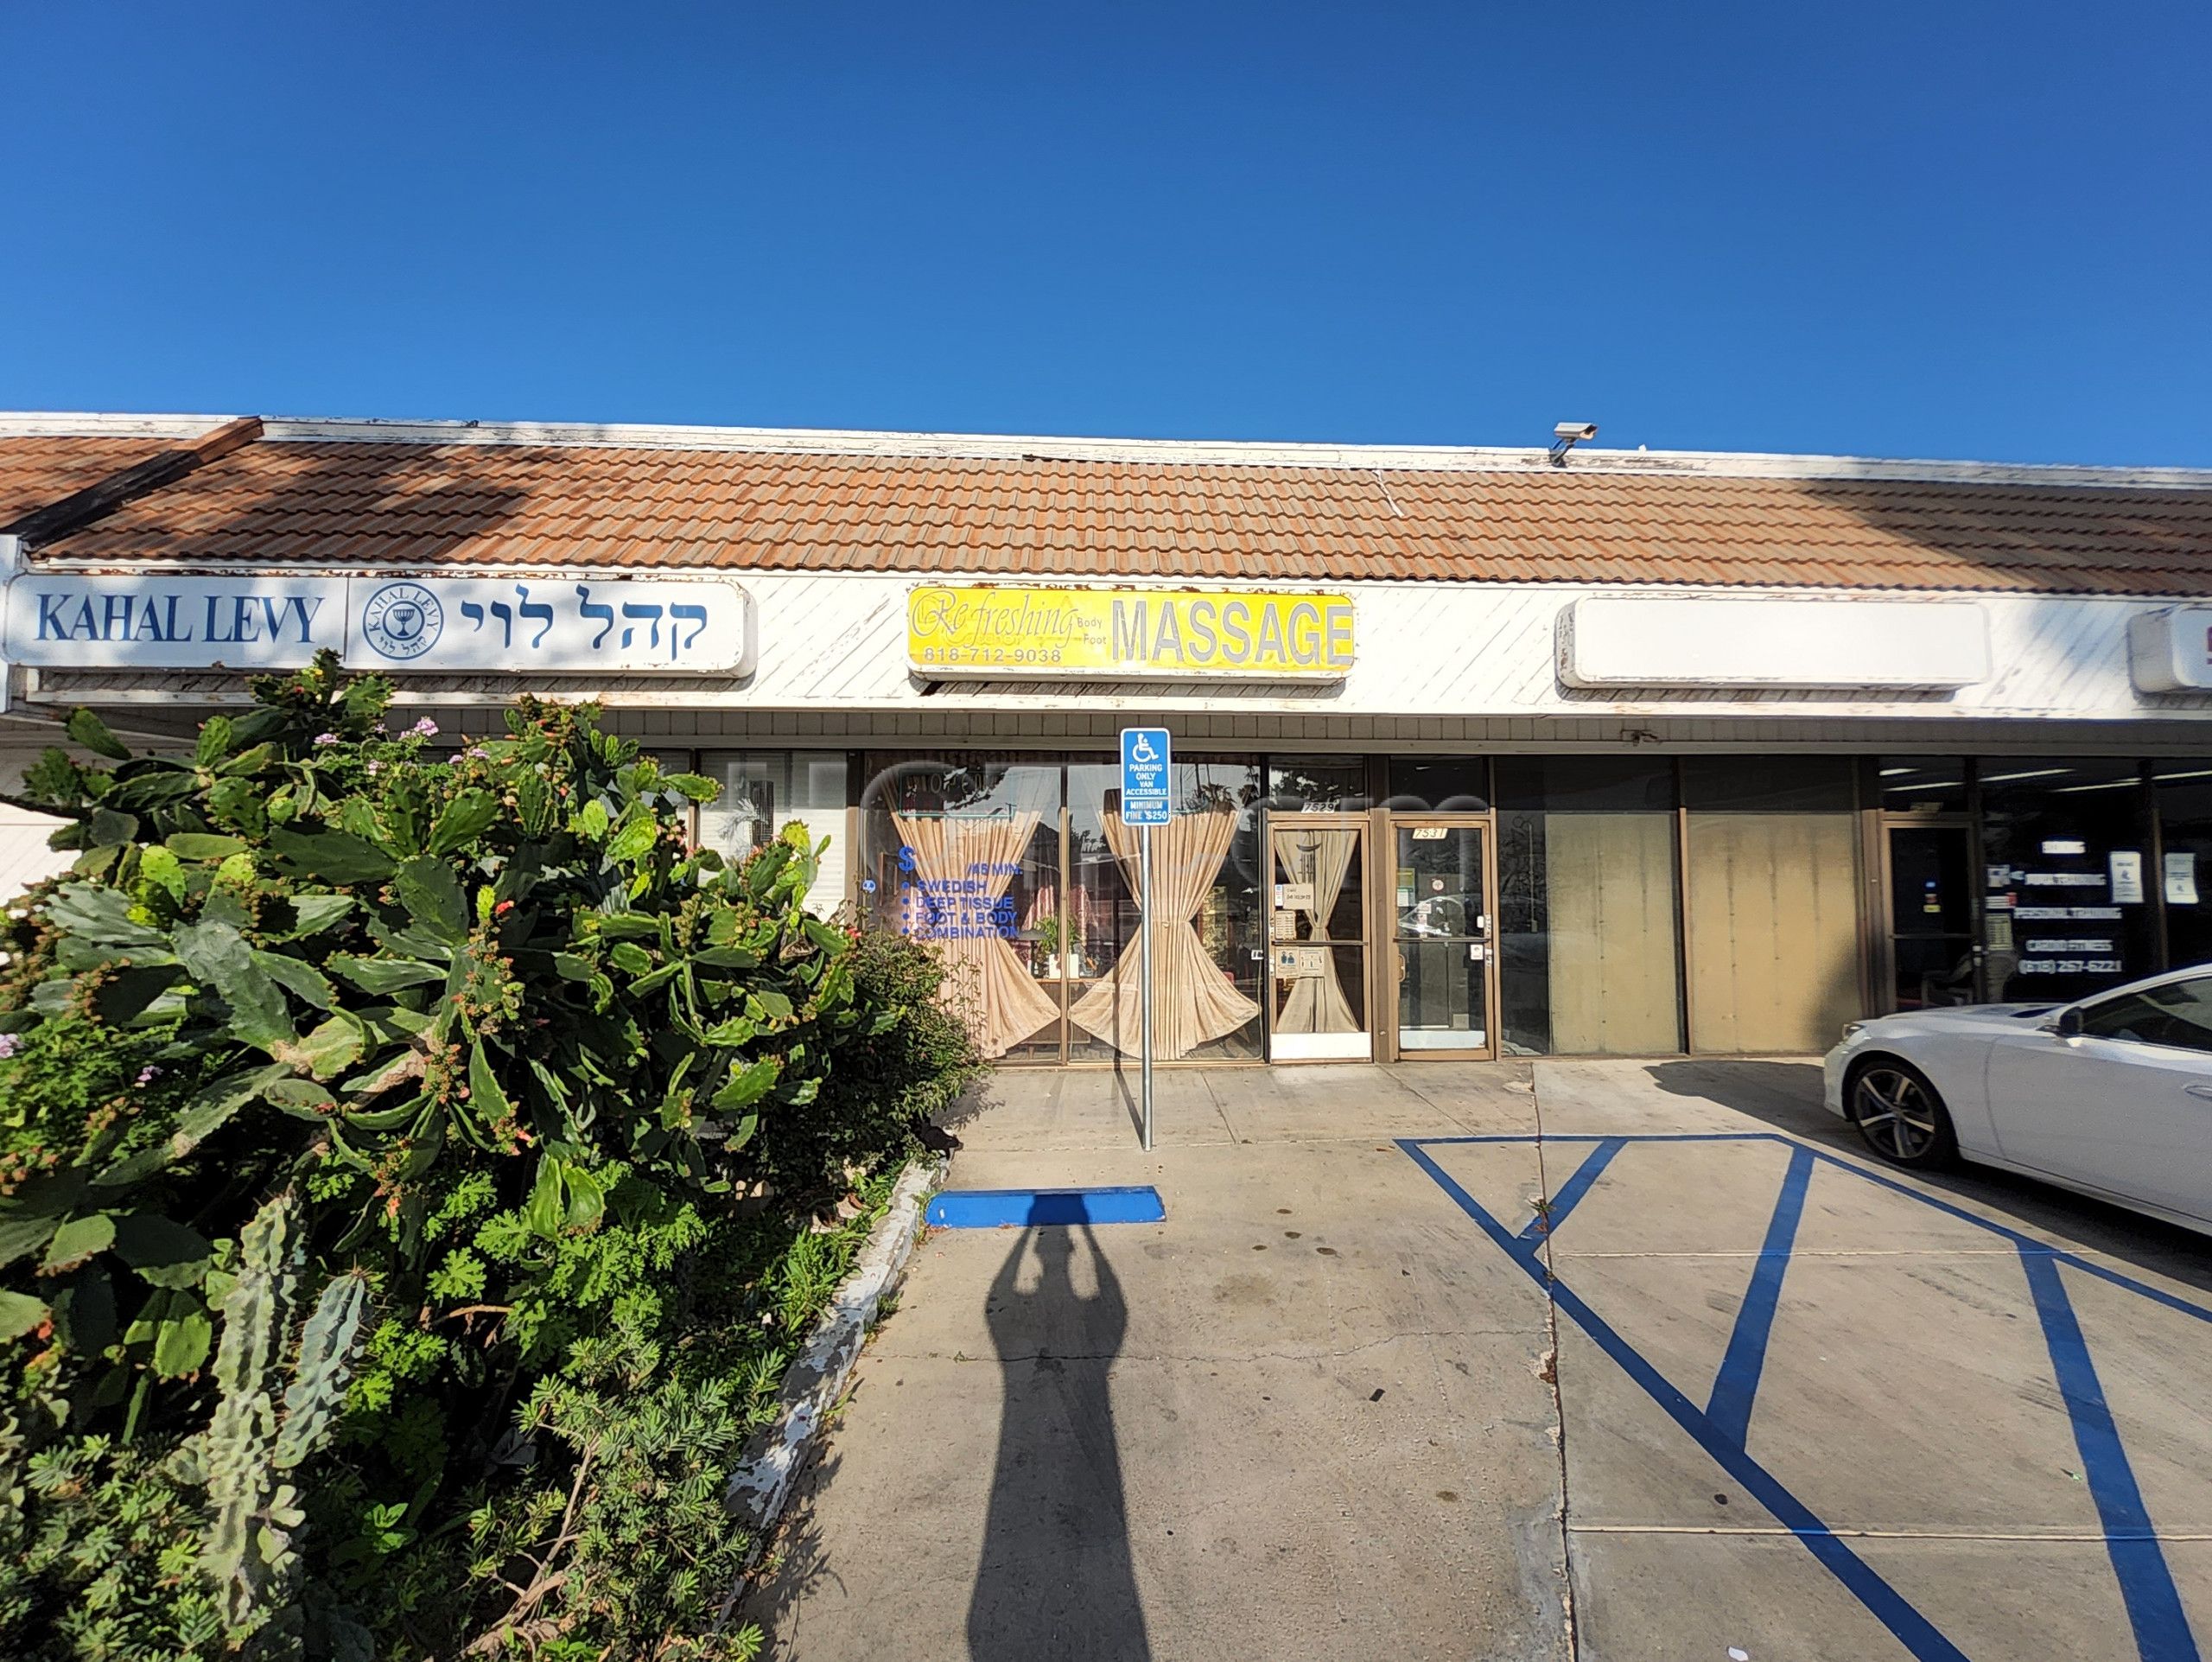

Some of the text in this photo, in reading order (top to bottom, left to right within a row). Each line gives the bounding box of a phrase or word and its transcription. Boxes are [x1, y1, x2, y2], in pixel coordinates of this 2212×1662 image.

[365, 587, 439, 632] KAHAL LEVY
[34, 593, 325, 644] KAHAL LEVY
[460, 583, 708, 662] קהל לוי
[1077, 616, 1103, 629] Body
[1112, 599, 1354, 665] MASSAGE
[379, 635, 427, 656] קהל לוי
[1083, 633, 1107, 646] Foot
[924, 647, 1062, 663] 818-712-9038
[1128, 763, 1163, 772] PARKING
[1135, 772, 1156, 780] ONLY
[1129, 800, 1163, 810] MINIMUM
[1305, 802, 1335, 812] 7529
[1125, 810, 1142, 820] FINE
[1415, 828, 1445, 837] 7531
[916, 880, 988, 894] SWEDISH
[916, 895, 1014, 909] DEEP TISSUE
[915, 911, 1018, 925] FOOT & BODY
[914, 926, 1020, 940] COMBINATION
